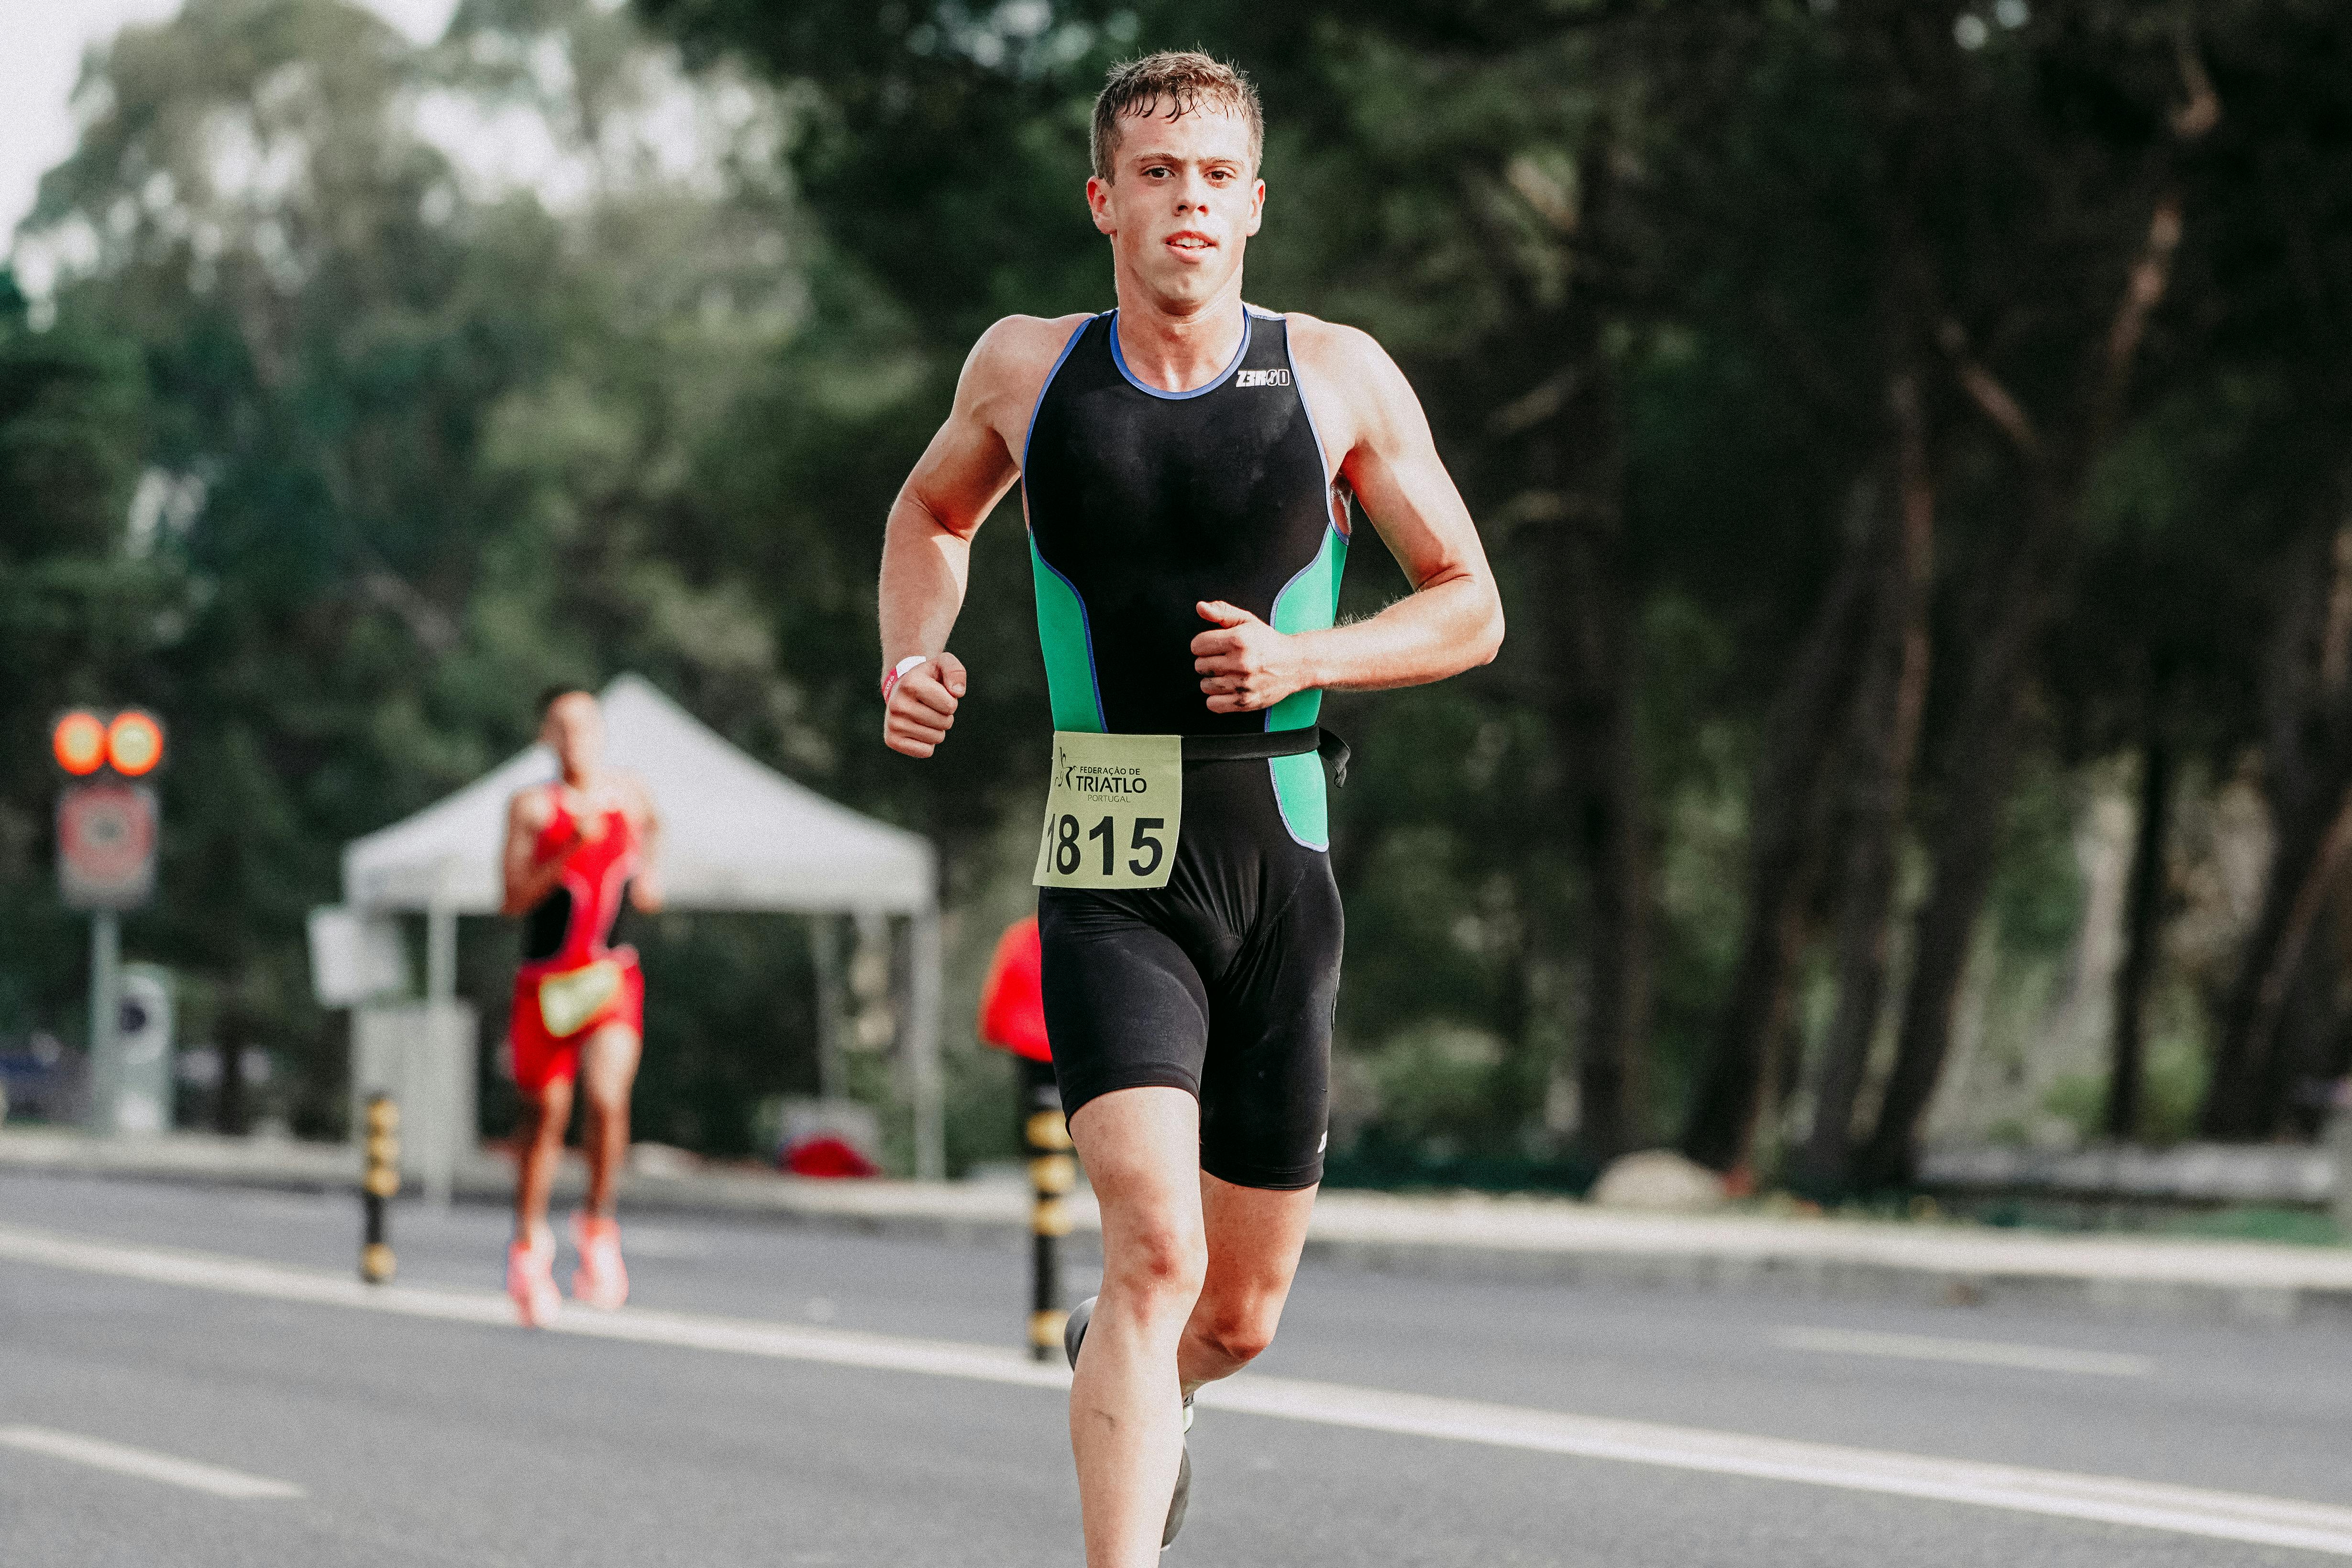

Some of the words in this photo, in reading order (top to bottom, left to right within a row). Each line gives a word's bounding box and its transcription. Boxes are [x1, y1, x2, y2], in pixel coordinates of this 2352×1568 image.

[1080, 766, 1126, 776] FEDERAÇÃO
[1076, 775, 1147, 794] TRIATLO
[1087, 794, 1131, 803] PORTUGAL
[1046, 813, 1165, 877] 1815
